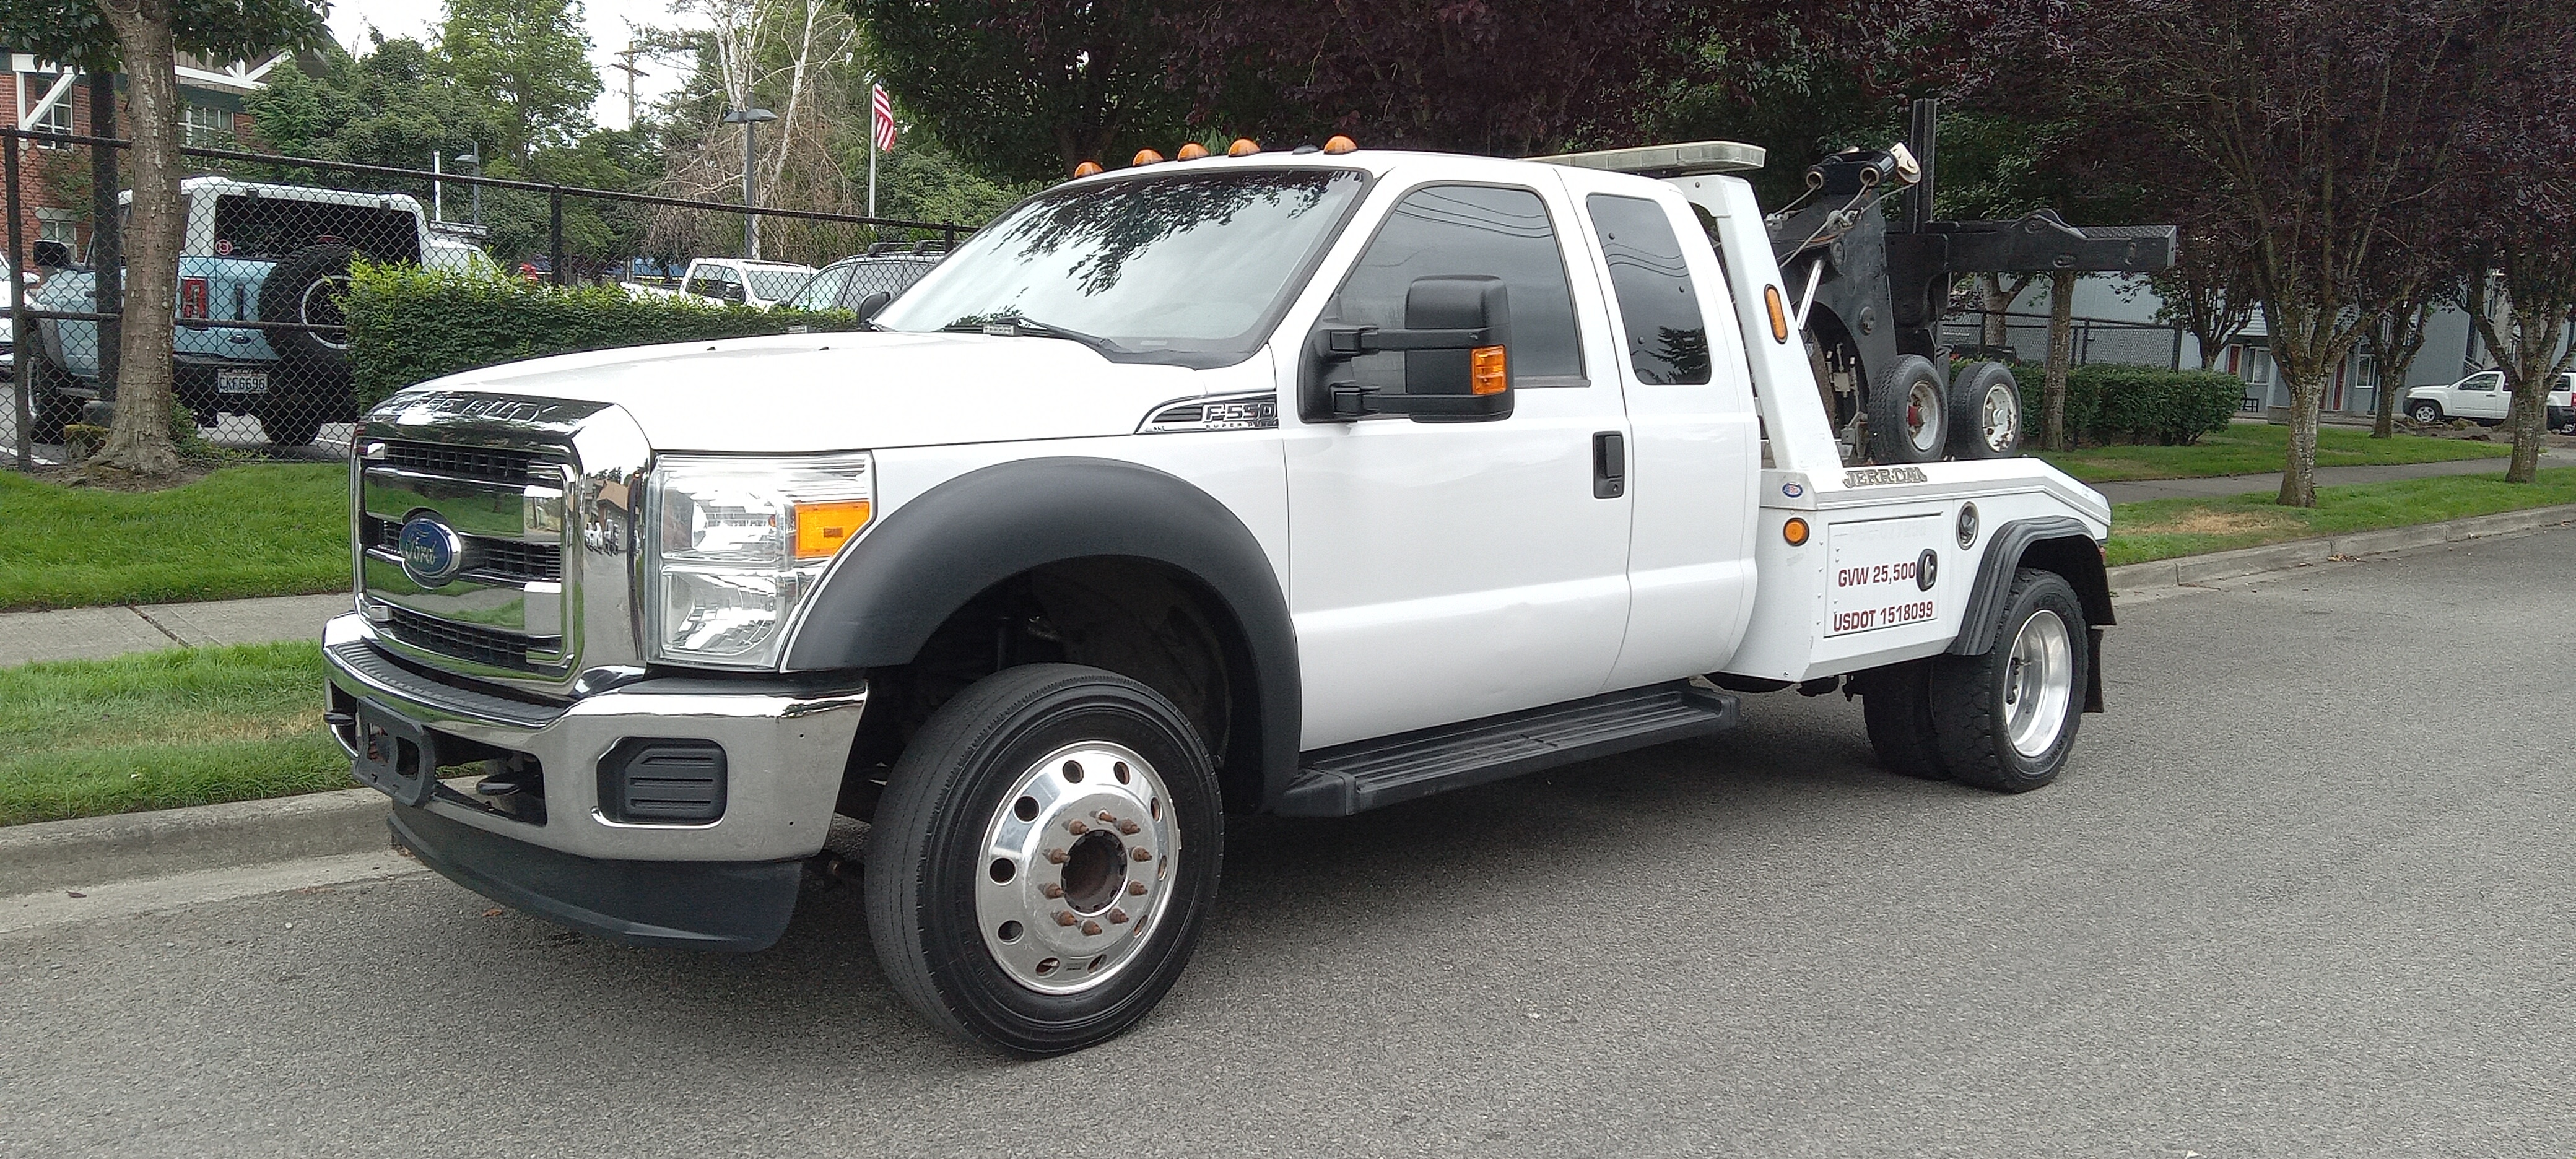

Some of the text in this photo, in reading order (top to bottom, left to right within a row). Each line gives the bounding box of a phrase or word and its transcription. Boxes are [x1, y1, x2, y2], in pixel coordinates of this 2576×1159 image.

[405, 527, 437, 565] Ford
[1838, 562, 1916, 588] GVW 25,500
[1834, 601, 1933, 632] USDOT 1518099
